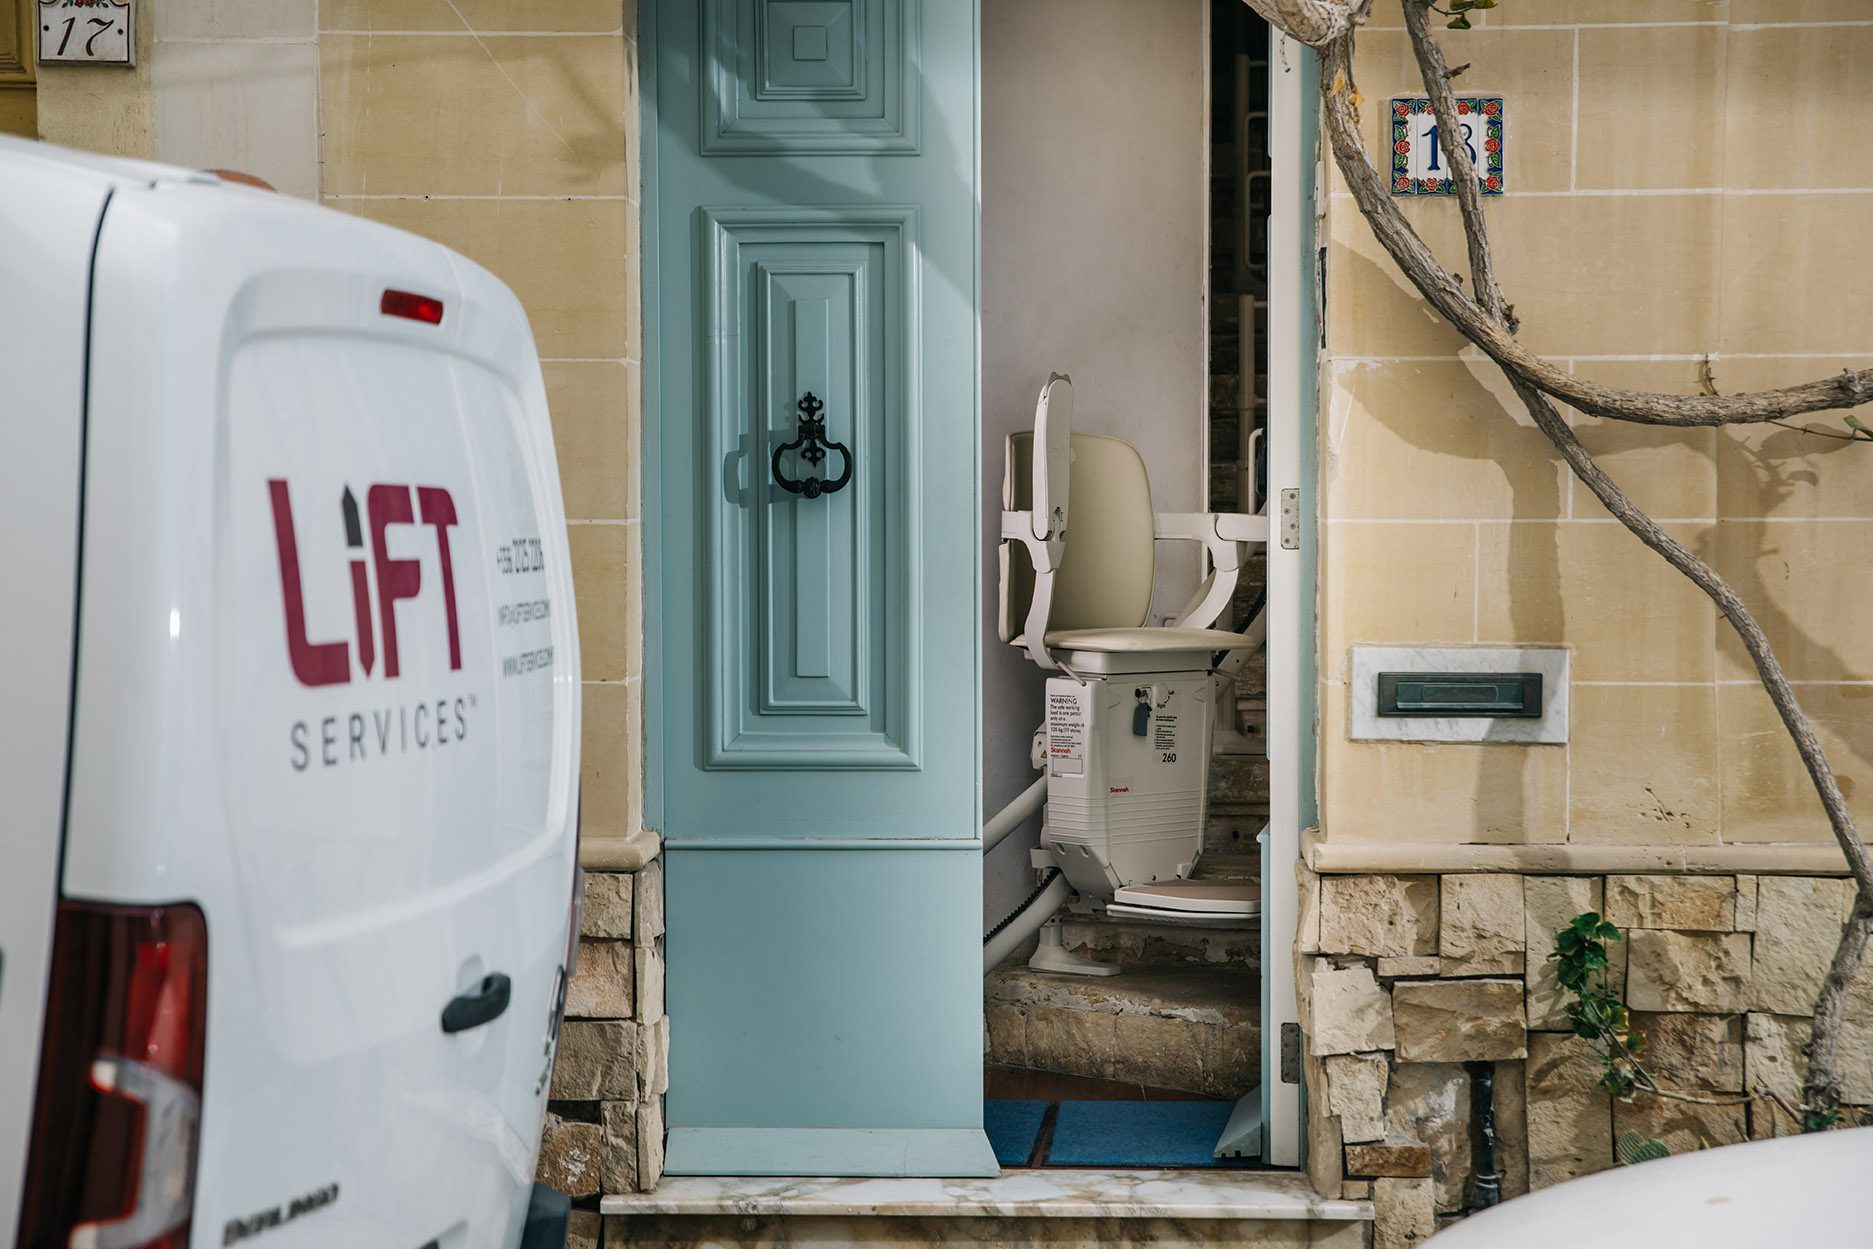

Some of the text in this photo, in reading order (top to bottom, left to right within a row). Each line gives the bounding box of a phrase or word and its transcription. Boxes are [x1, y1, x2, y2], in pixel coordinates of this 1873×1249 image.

[57, 17, 115, 57] 17
[1050, 746, 1072, 754] Stannah
[1162, 752, 1177, 763] 260
